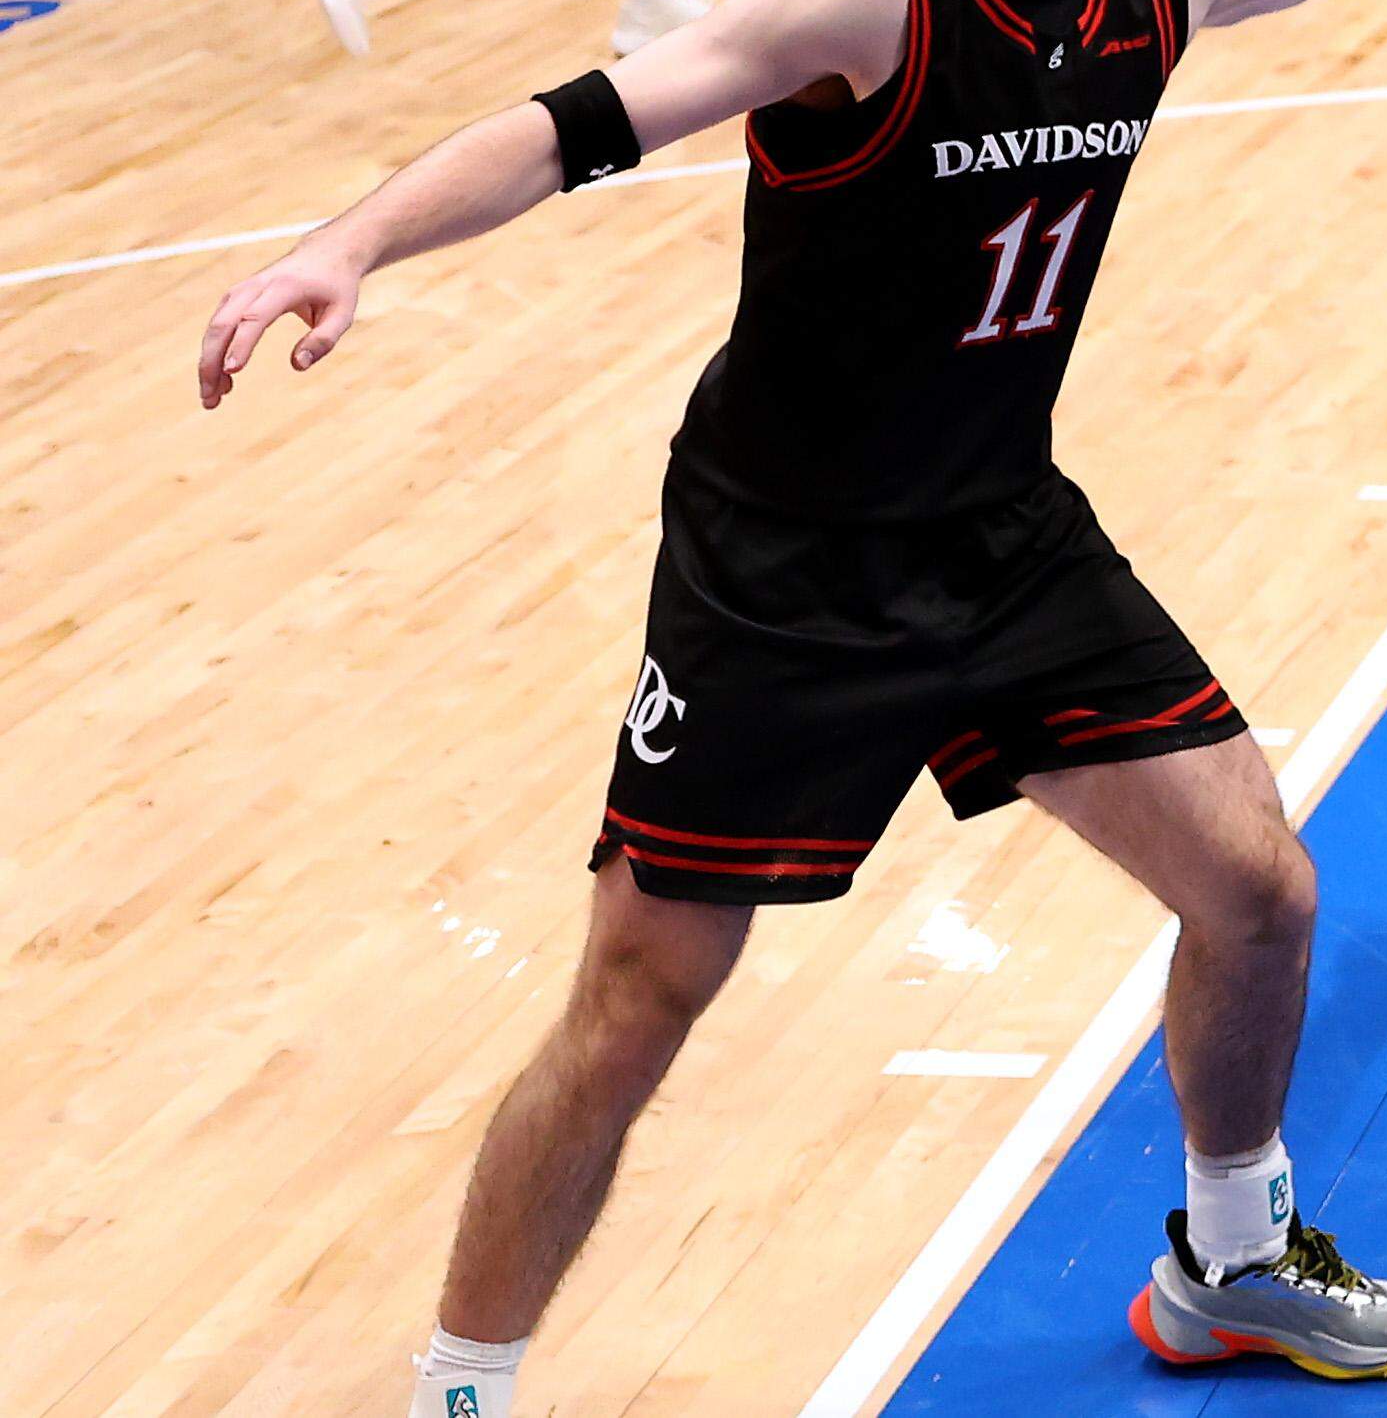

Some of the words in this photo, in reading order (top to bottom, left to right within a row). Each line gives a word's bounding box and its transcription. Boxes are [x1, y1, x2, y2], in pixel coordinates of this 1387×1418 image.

[931, 118, 1148, 179] DAVIDSON
[955, 188, 1095, 350] 11
[624, 654, 687, 764] DC
